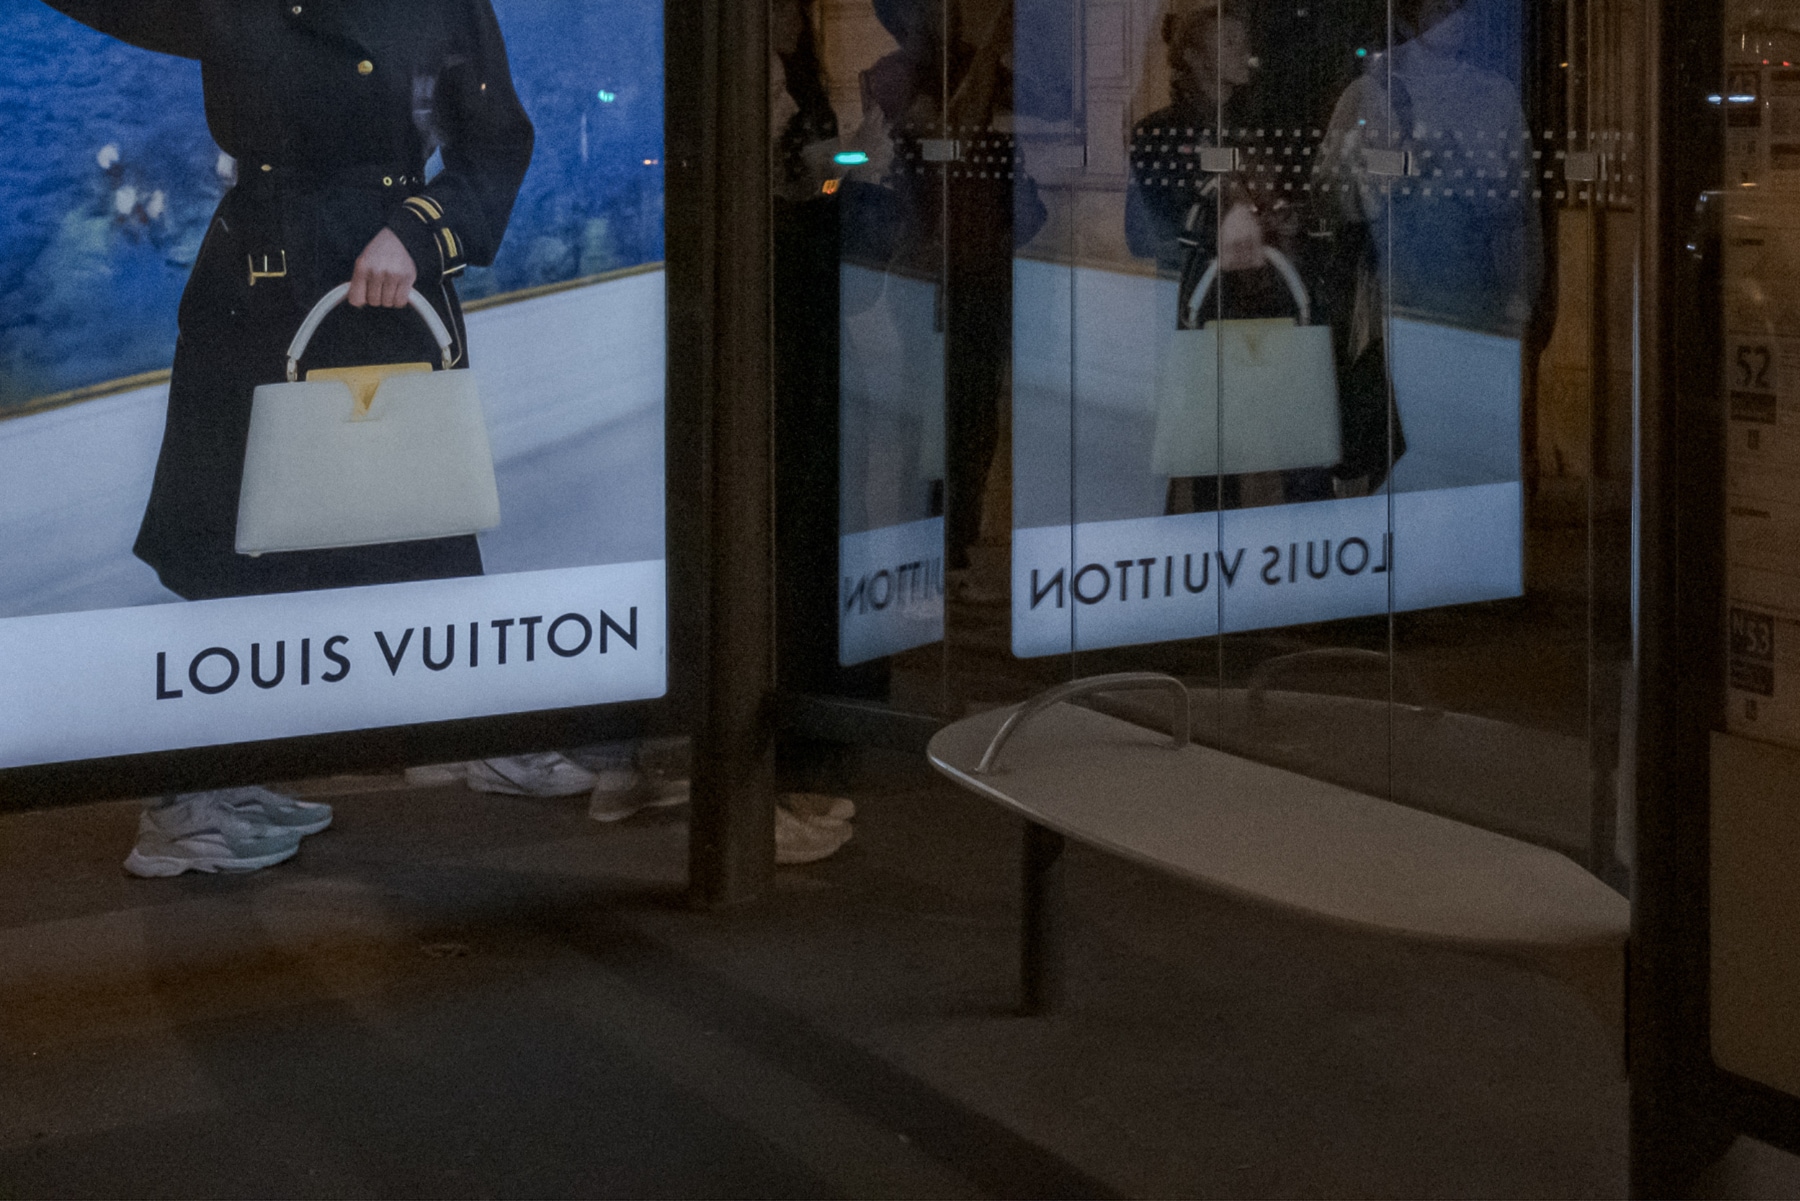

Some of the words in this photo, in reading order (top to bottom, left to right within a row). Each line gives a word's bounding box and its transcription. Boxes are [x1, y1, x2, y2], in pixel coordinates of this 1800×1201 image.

[1736, 345, 1771, 389] 52
[156, 634, 352, 701] LOUIS
[373, 606, 639, 677] VUITTON
